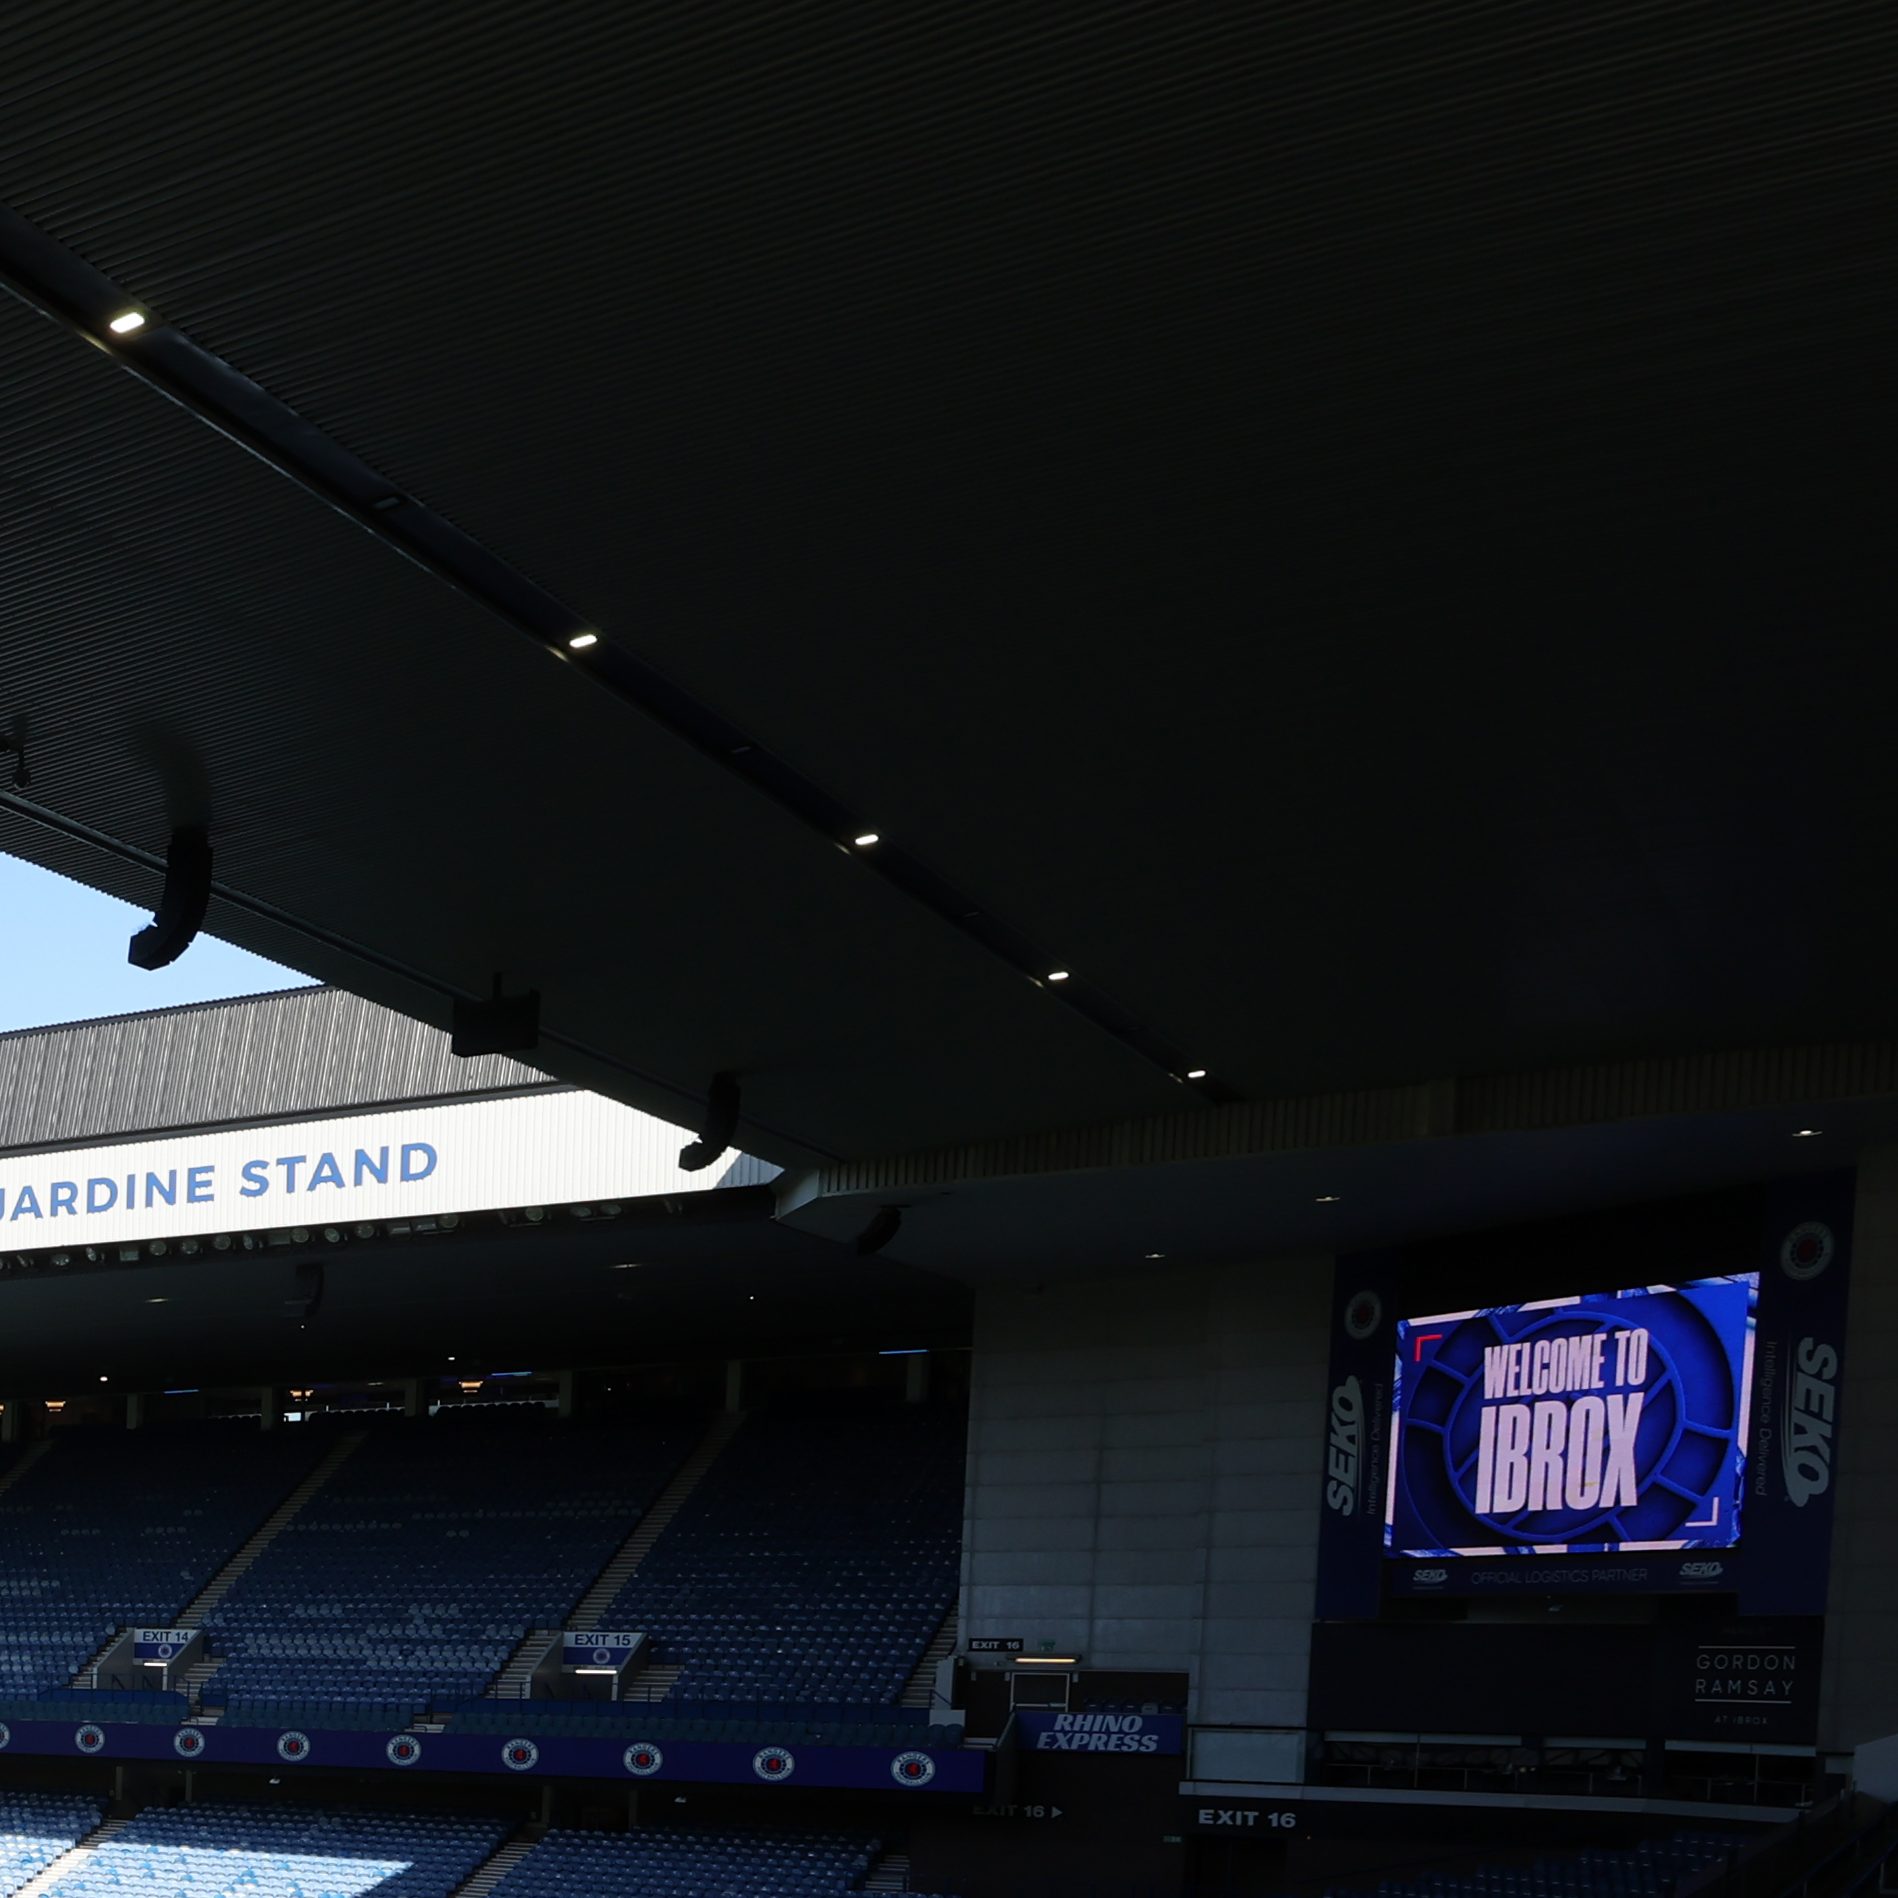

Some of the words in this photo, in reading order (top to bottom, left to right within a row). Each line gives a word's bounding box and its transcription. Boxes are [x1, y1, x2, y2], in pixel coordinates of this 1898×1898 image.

[240, 1142, 438, 1199] STAND
[1483, 1333, 1608, 1400] WELCOME
[1614, 1327, 1650, 1388] TO
[1759, 1341, 1778, 1424] Intelligence
[1372, 1383, 1385, 1442] Delivered
[1791, 1337, 1839, 1507] SEKO
[1326, 1374, 1363, 1517] SEKO
[1475, 1390, 1645, 1515] IBROX
[1755, 1428, 1773, 1496] Delivered
[1366, 1443, 1379, 1516] Intelligence
[1412, 1568, 1449, 1584] SEKO
[1470, 1570, 1522, 1585] OFFICIAL
[1525, 1569, 1589, 1585] LOGISTICS
[1591, 1568, 1648, 1584] PARTNER
[1679, 1561, 1724, 1579] SEKO
[144, 1631, 172, 1641] EXIT
[175, 1632, 189, 1641] 14
[575, 1634, 610, 1646] EXIT
[614, 1634, 631, 1646] 15
[971, 1640, 1000, 1650] EXIT
[1005, 1640, 1020, 1650] 16
[1696, 1654, 1796, 1670] GORDON
[1695, 1678, 1794, 1696] RAMSAY
[1054, 1713, 1143, 1733] RHINO
[1733, 1716, 1768, 1725] IBROX
[1036, 1731, 1160, 1752] EXPRESS
[1022, 1804, 1045, 1818] 16
[1198, 1808, 1259, 1827] EXIT
[1266, 1811, 1298, 1829] 16
